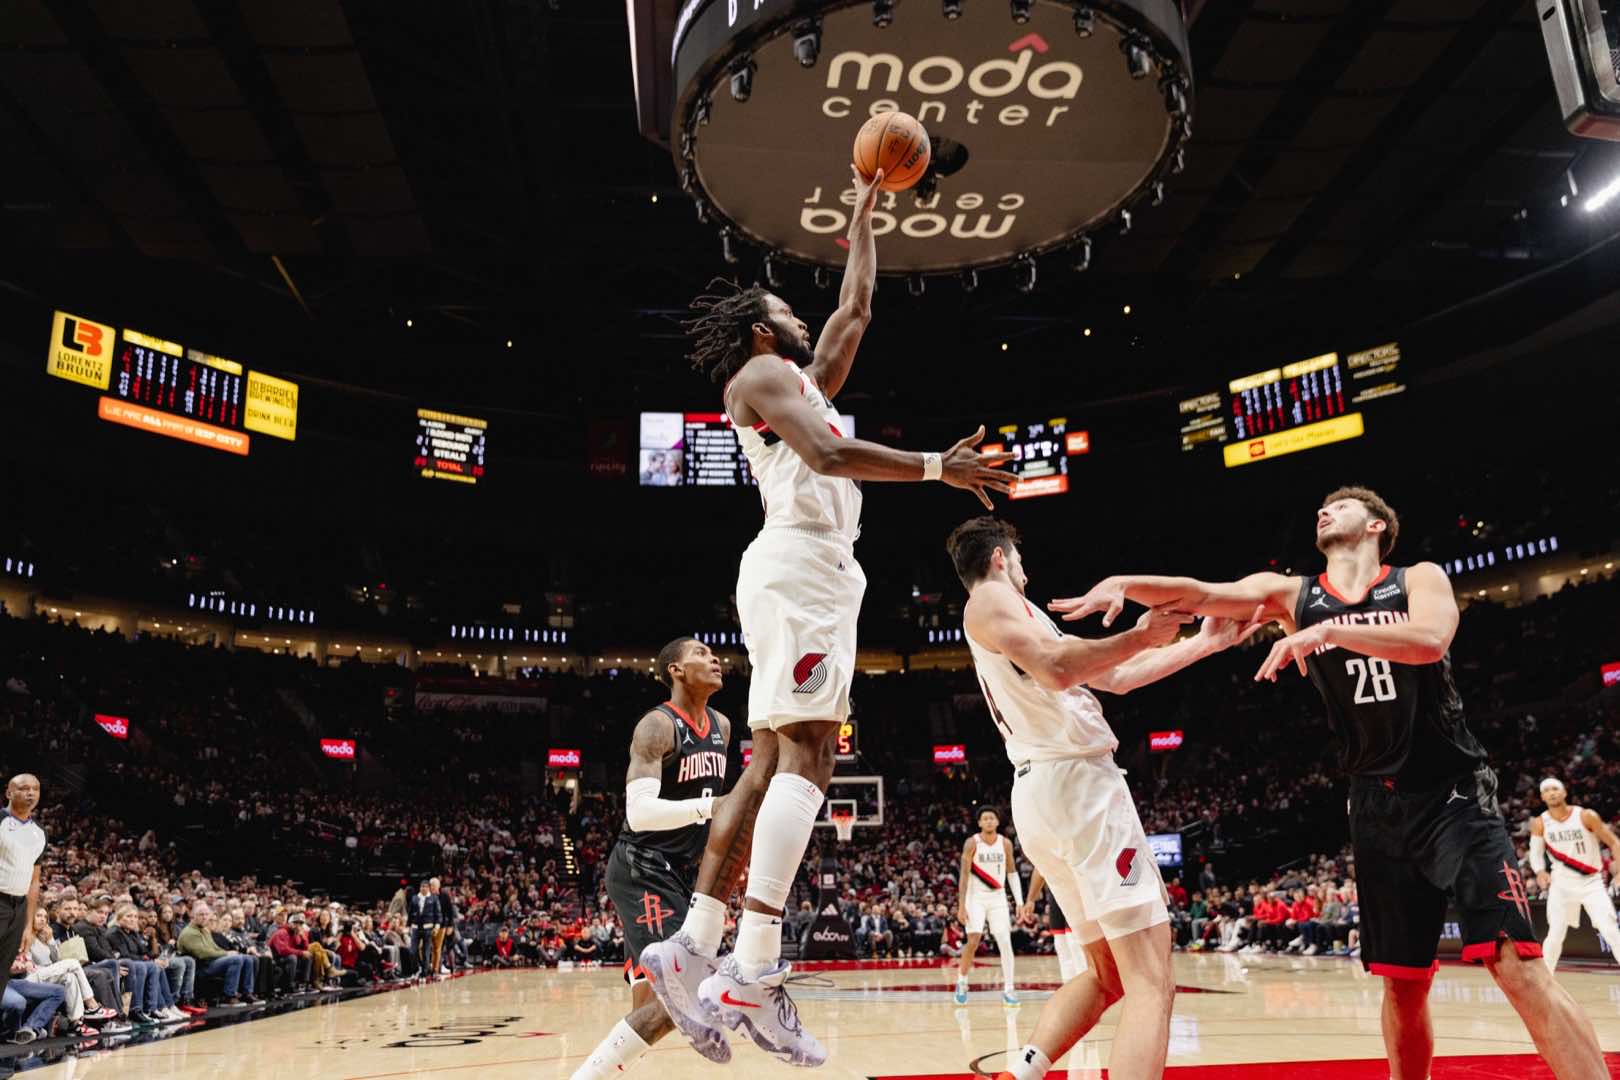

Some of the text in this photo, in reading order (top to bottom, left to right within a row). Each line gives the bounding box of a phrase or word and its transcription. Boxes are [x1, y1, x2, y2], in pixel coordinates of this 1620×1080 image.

[827, 48, 1083, 99] moda
[822, 95, 1069, 127] center
[57, 351, 103, 371] LORENTZ
[56, 360, 103, 381] BRUUN
[436, 460, 464, 473] TOTAL
[1345, 656, 1397, 704] 28
[101, 720, 127, 735] oda
[322, 741, 354, 755] moda
[838, 735, 850, 753] 5
[549, 752, 580, 763] moda
[1576, 841, 1586, 854] 11
